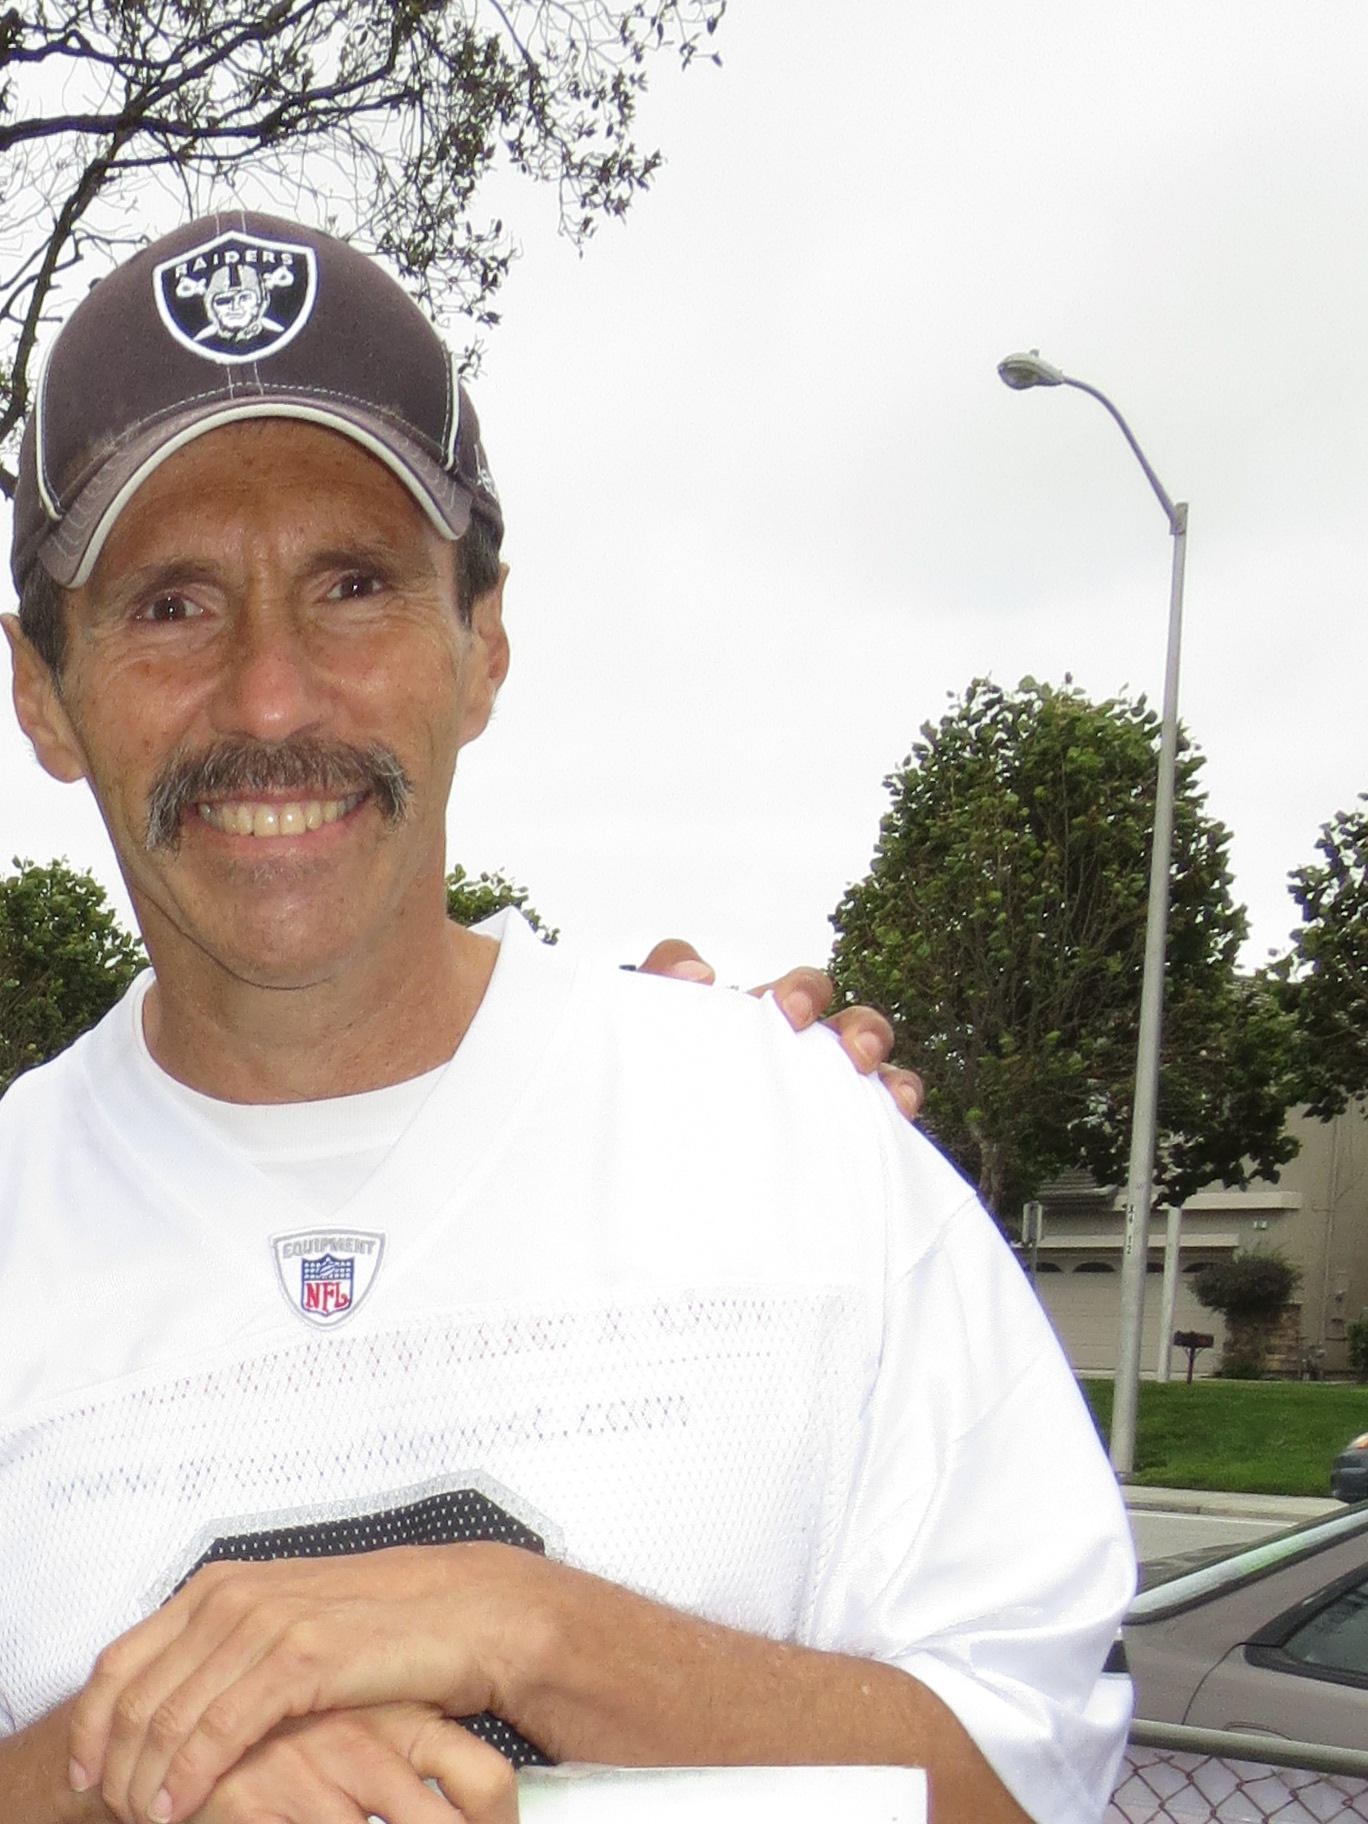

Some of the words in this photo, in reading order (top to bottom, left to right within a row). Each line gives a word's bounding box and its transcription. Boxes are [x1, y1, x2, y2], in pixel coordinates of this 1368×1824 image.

[175, 250, 294, 278] RAIDERS
[283, 1236, 376, 1259] EQUIPMENT
[305, 1281, 351, 1314] NFL
